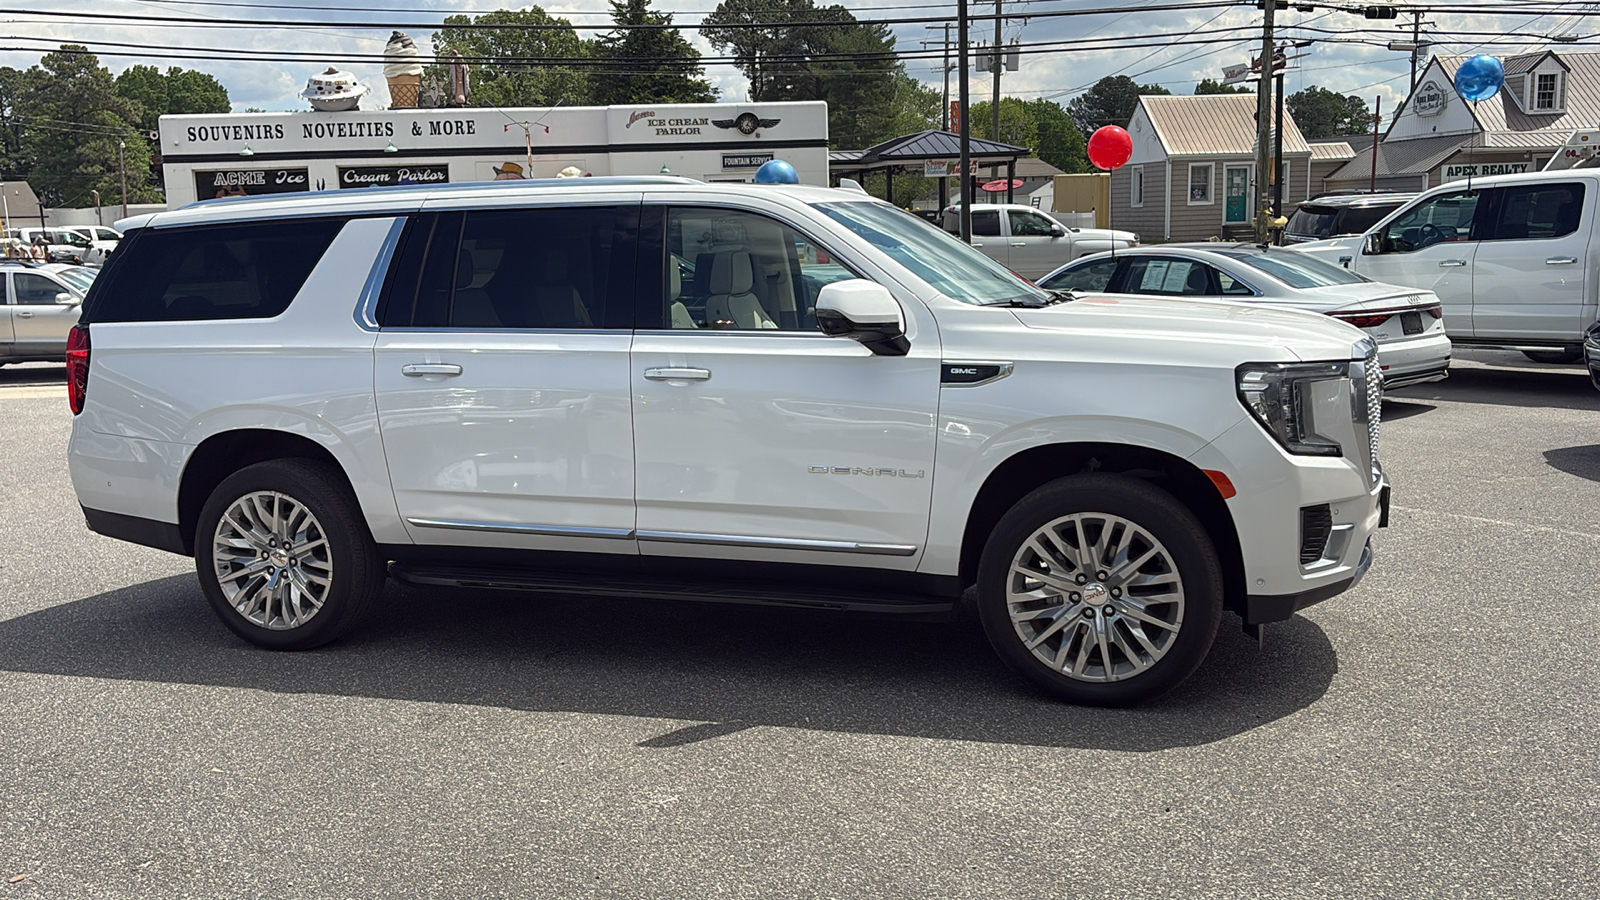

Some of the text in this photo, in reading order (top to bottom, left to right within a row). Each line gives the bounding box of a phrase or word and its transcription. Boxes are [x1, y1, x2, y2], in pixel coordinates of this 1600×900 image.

[668, 118, 709, 126] CREAM
[187, 120, 476, 141] SOUVENIRS NOVELTIES & MORE
[724, 157, 750, 165] FOUNTAIN
[343, 168, 446, 183] Cream Parlor
[1446, 164, 1528, 176] APEX REALTY
[213, 171, 306, 185] ACME Ice
[950, 367, 977, 375] GMC
[808, 465, 924, 479] DENALI
[1085, 590, 1106, 600] GMC
